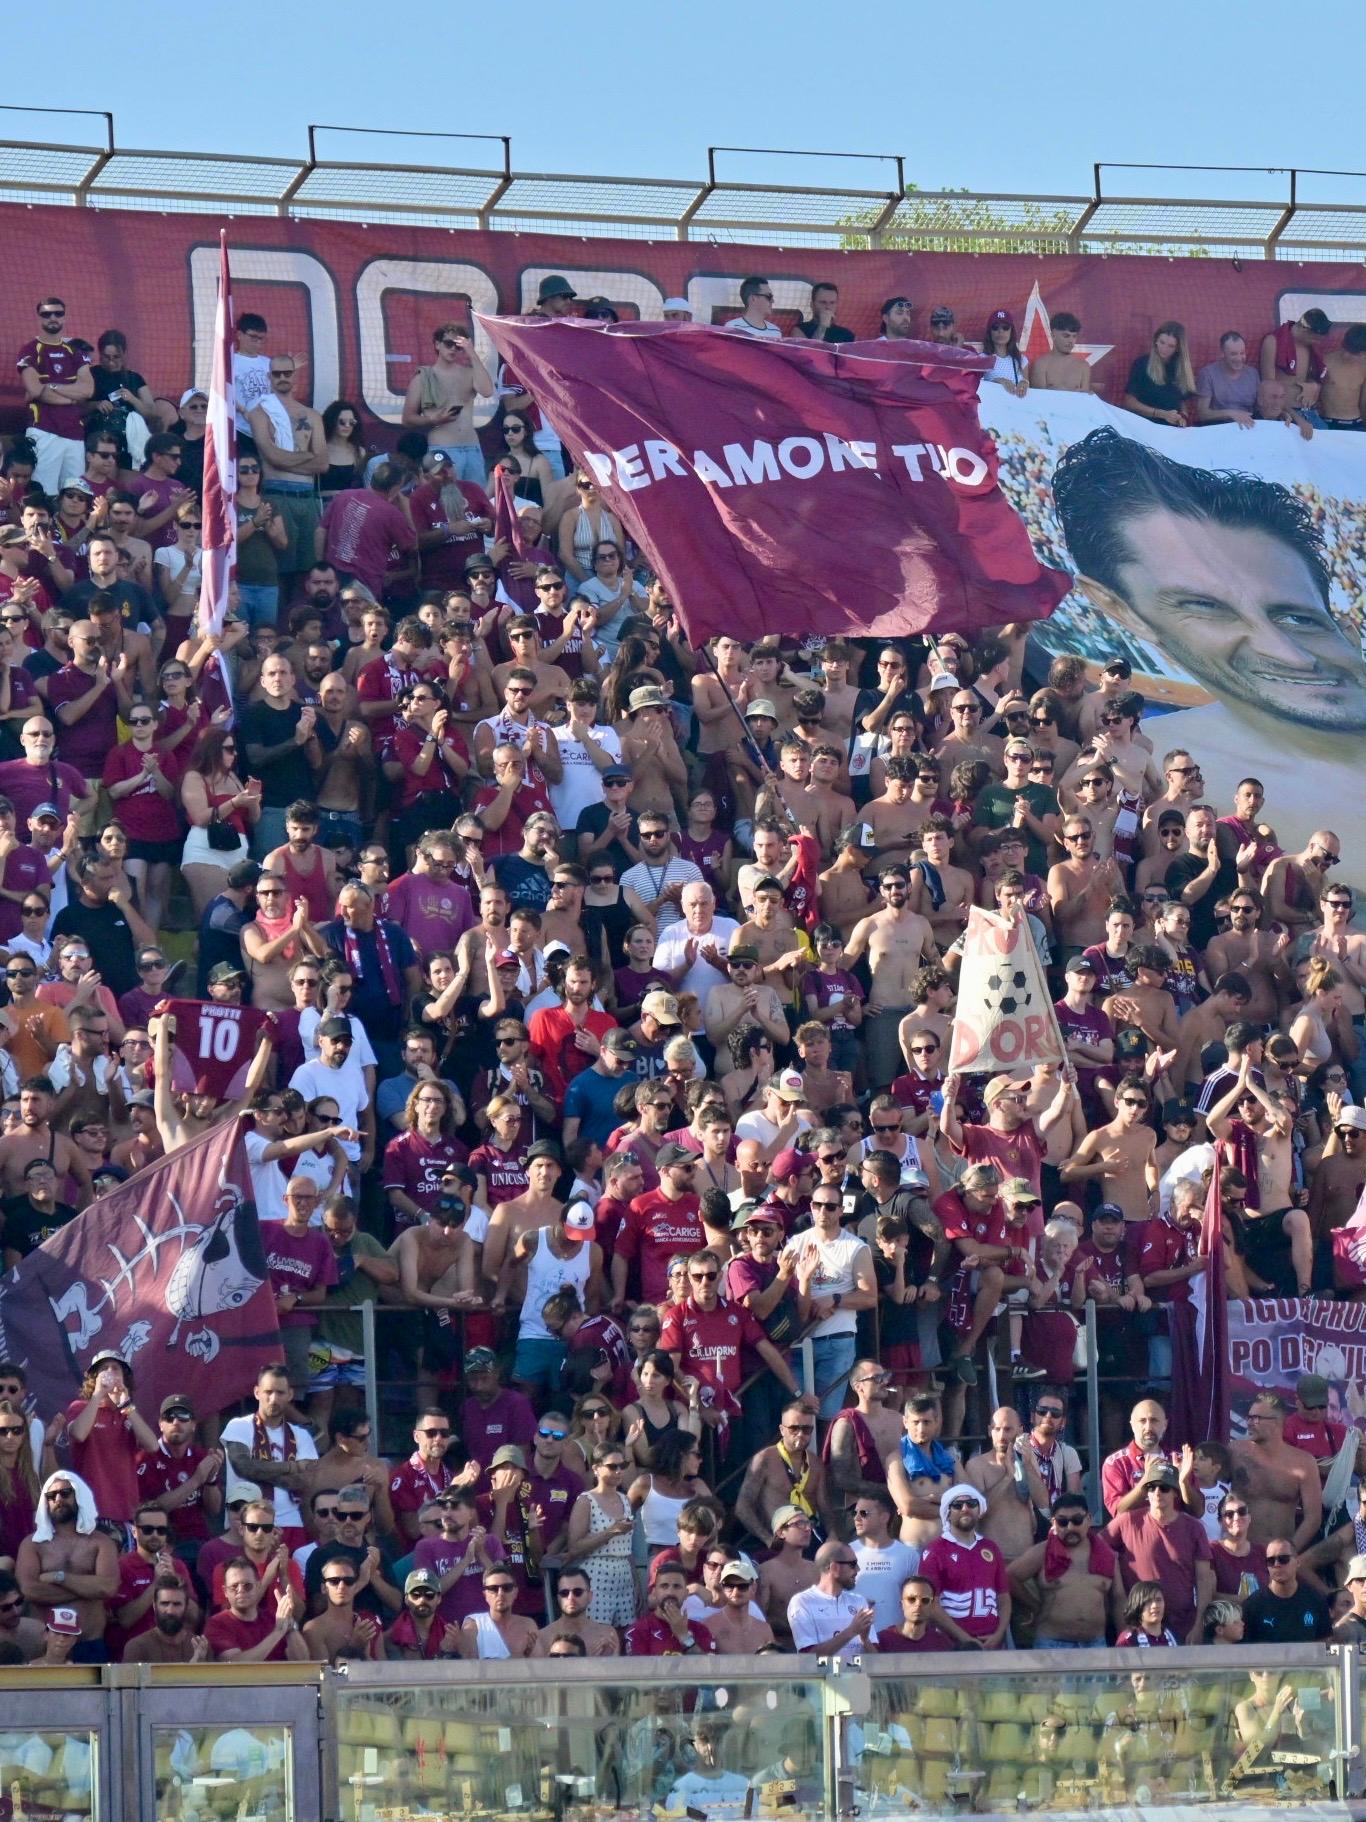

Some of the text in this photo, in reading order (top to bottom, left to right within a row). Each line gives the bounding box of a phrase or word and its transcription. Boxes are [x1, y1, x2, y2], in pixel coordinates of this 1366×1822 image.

[511, 887, 549, 903] adida
[198, 1017, 242, 1063] 10
[669, 1226, 702, 1237] CARIGE
[1230, 1337, 1273, 1376] PO
